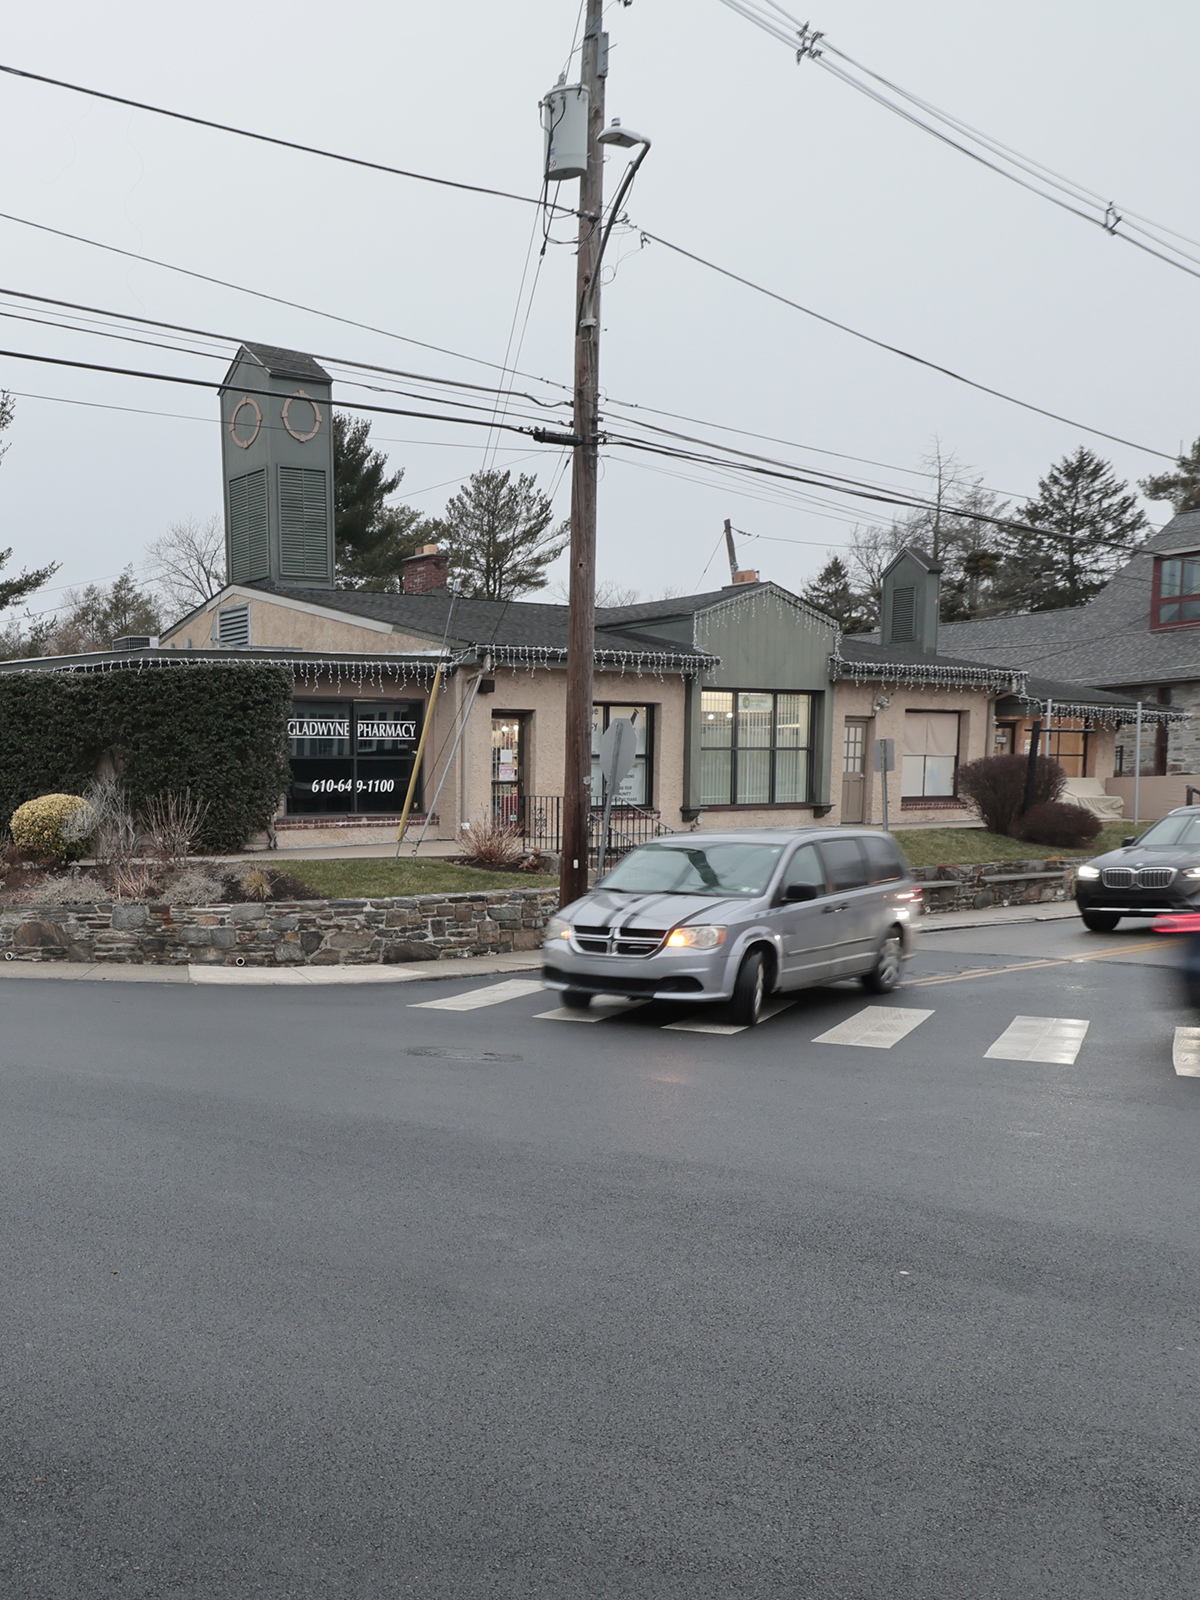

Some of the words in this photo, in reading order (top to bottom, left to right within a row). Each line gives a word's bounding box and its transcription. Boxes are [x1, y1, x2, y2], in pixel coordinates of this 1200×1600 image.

[287, 721, 350, 736] GLADWYNE
[357, 723, 416, 737] PHARMACY
[311, 779, 395, 793] 610-649-1100
